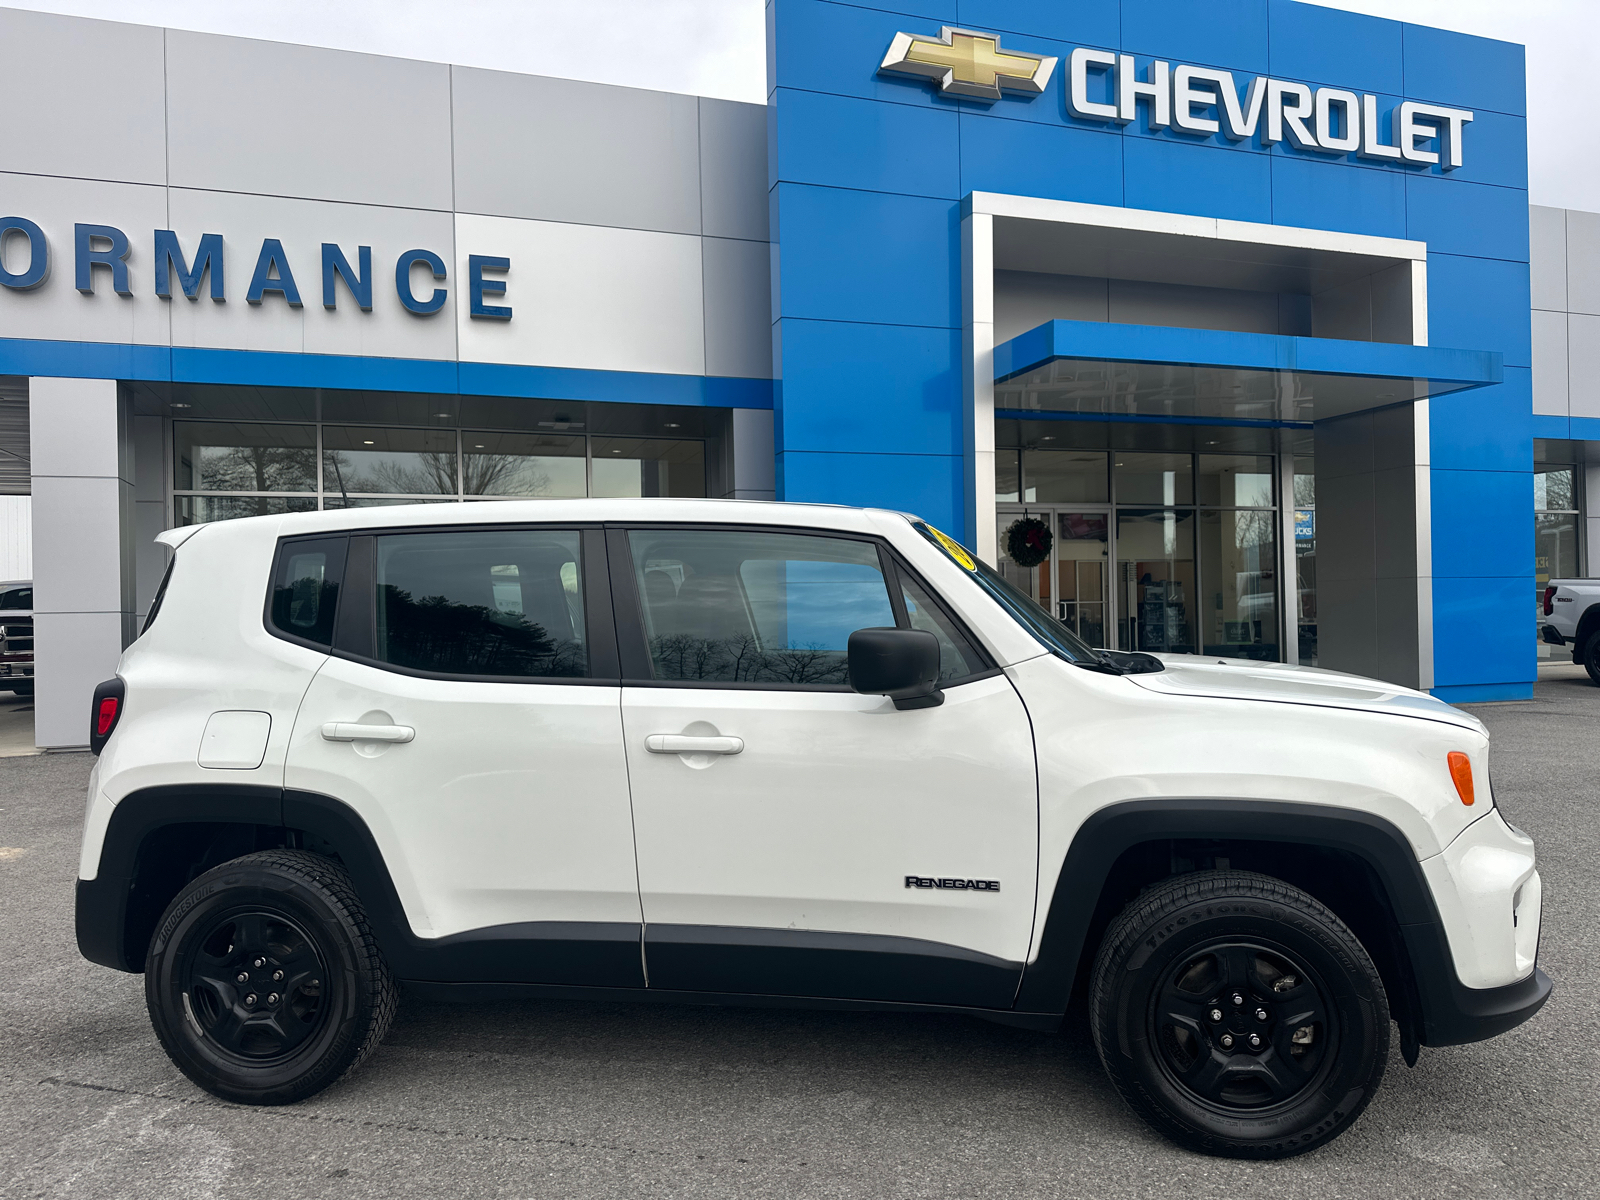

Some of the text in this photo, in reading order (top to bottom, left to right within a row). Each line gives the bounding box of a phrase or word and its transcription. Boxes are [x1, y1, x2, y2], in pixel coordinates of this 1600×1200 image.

[1068, 47, 1474, 169] CHEVROLET
[0, 216, 512, 321] ORMANCE
[159, 884, 216, 946] BRIDGESTONE
[905, 876, 1000, 892] RENEGADE
